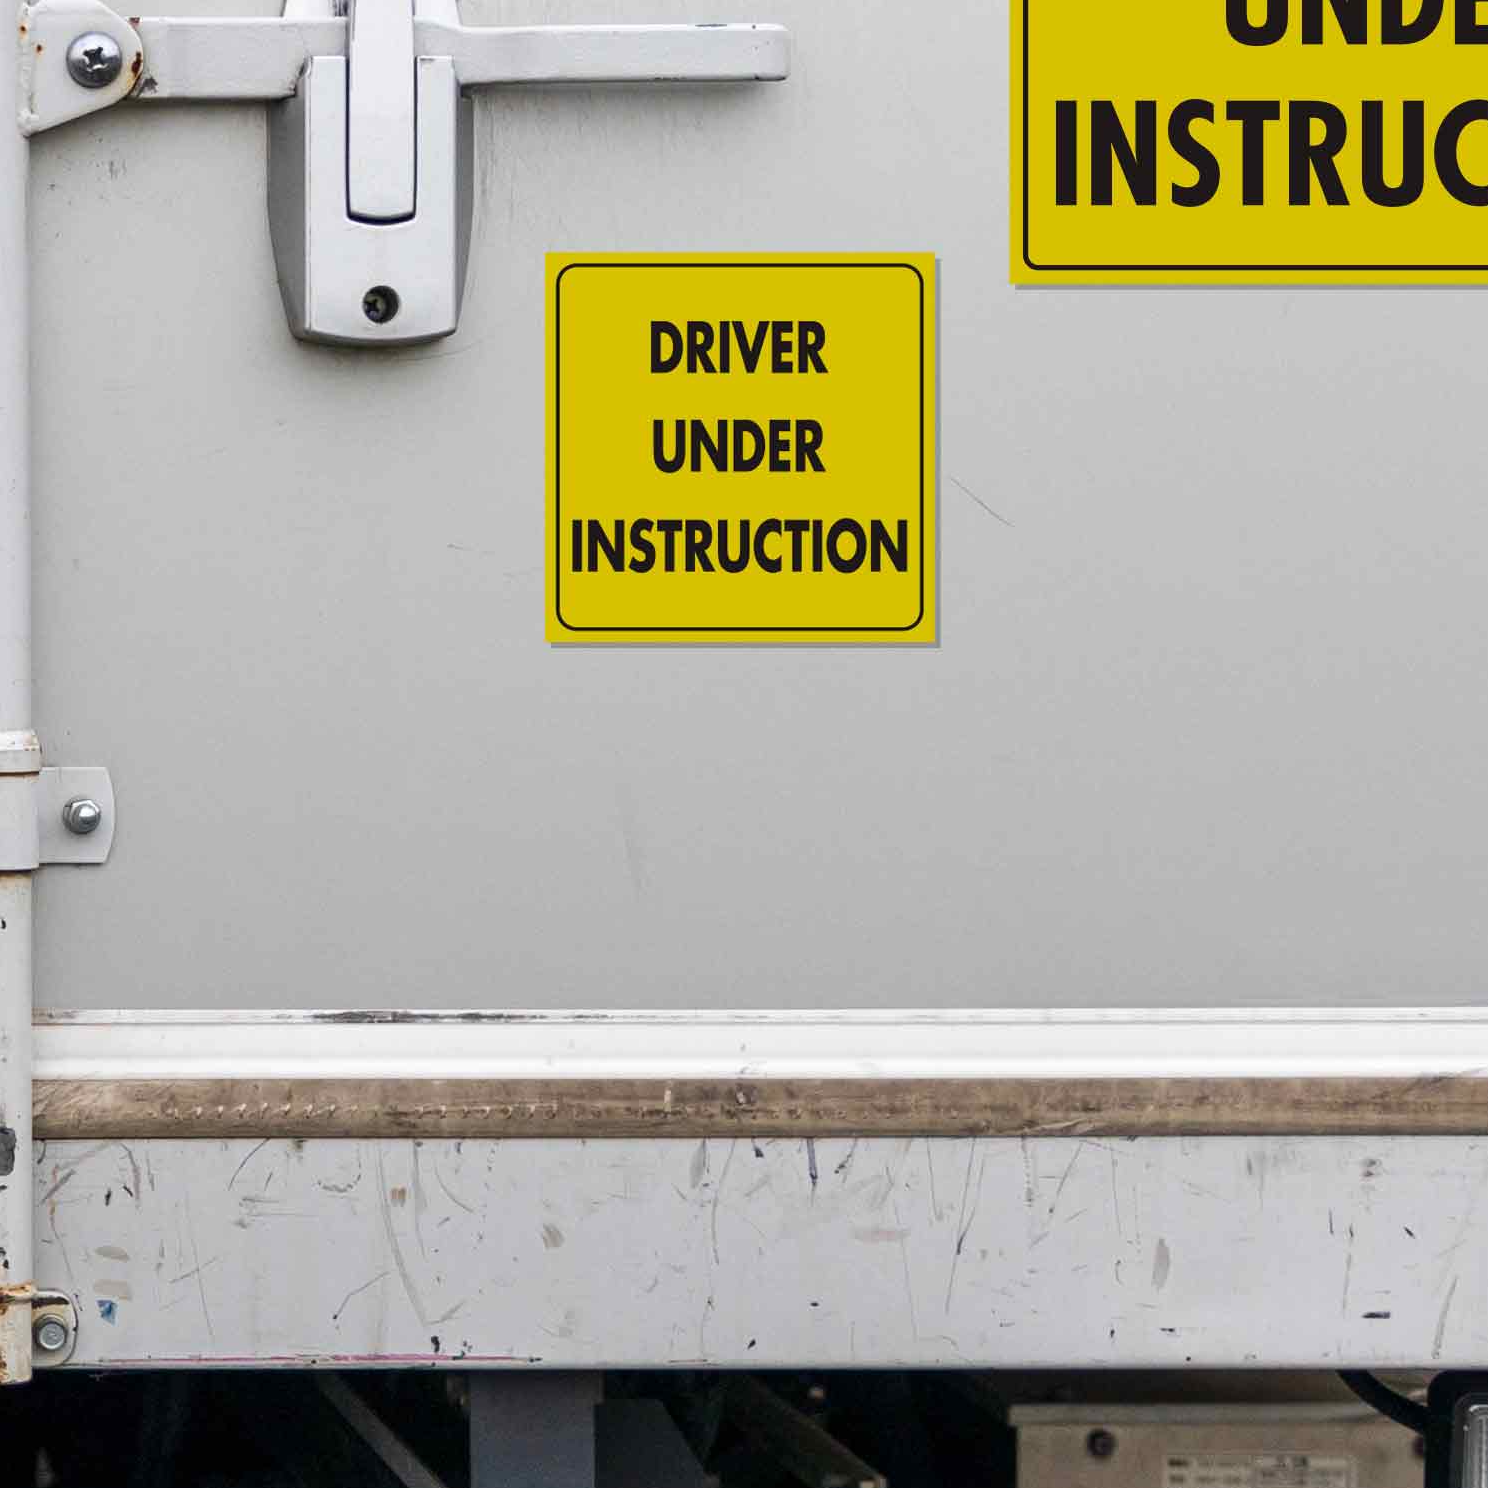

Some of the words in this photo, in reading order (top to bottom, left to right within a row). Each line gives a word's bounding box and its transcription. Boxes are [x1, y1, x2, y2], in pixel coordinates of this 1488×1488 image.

[651, 321, 828, 373] DRIVER
[654, 420, 825, 473] UNDER
[572, 518, 907, 573] INSTRUCTION
